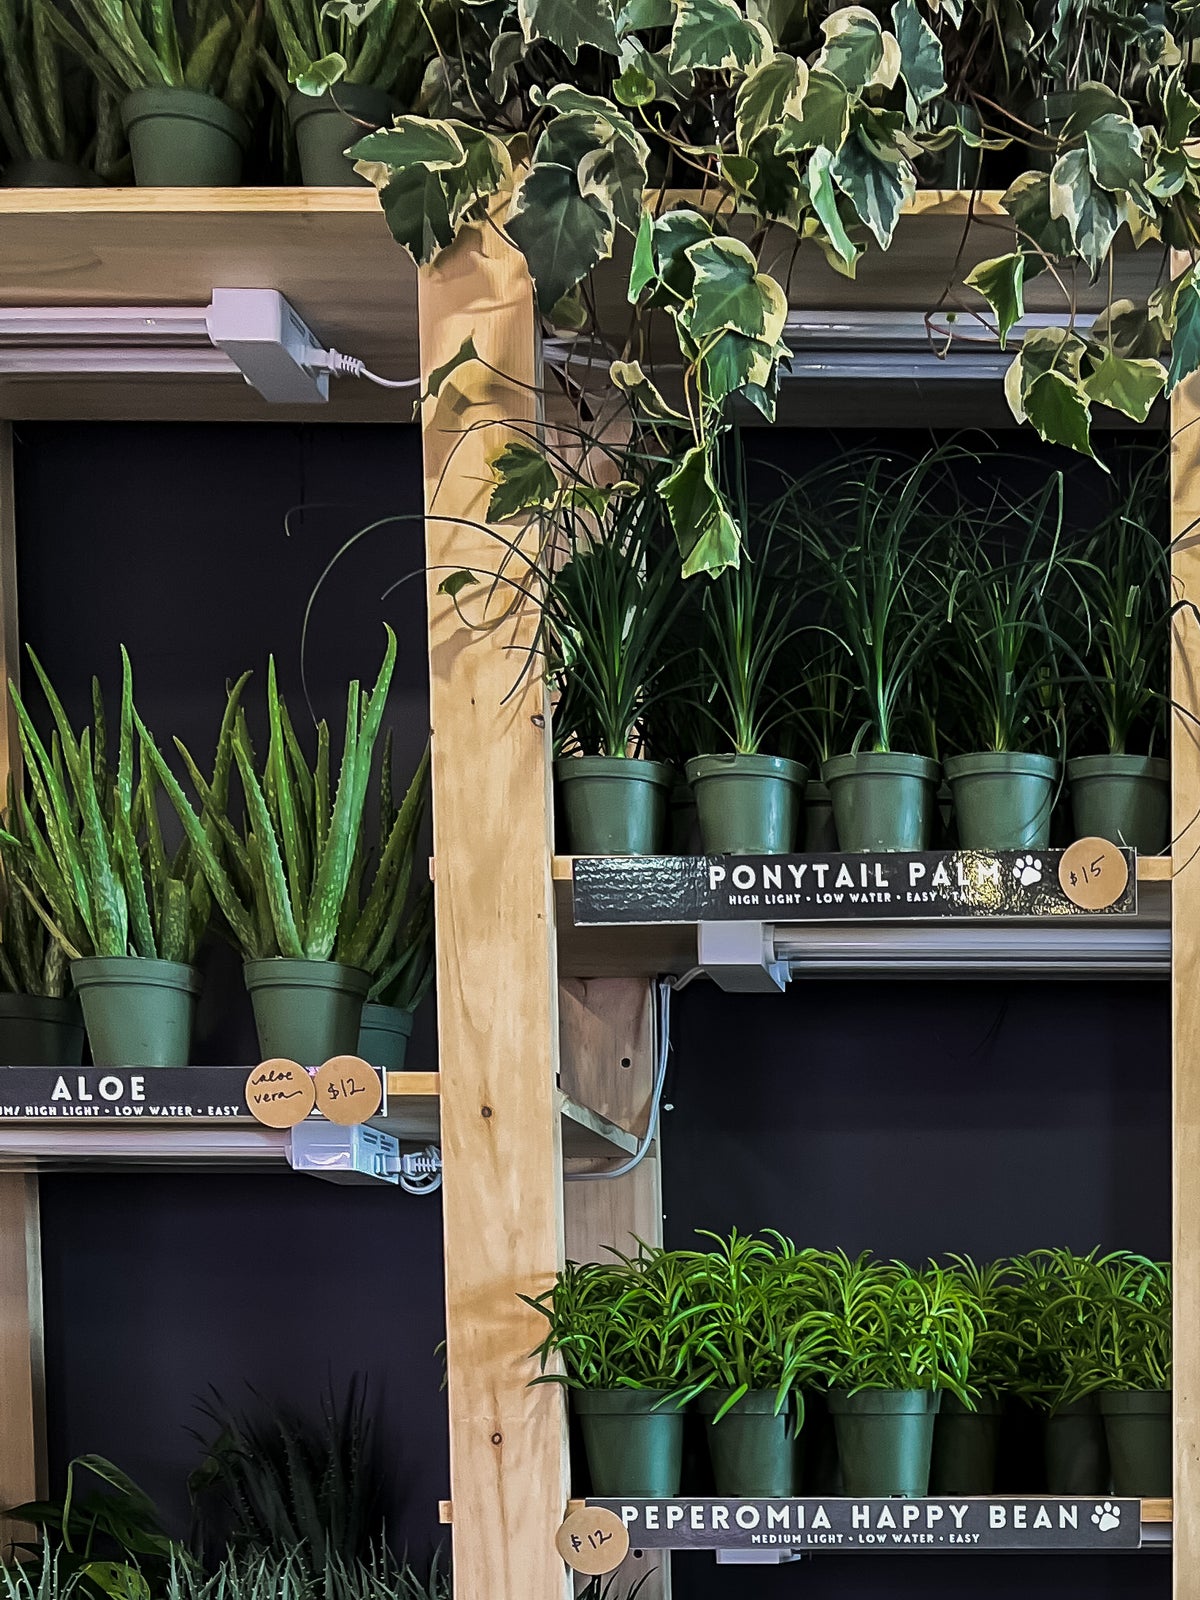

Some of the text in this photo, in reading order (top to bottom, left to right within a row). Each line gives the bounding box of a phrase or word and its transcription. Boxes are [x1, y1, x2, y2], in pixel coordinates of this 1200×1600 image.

[709, 861, 1001, 889] PONYTAIL PALM
[728, 890, 938, 905] HIGH LIGHT LOW WATER EASY
[52, 1076, 145, 1100] ALOE
[253, 1090, 303, 1104] vera
[25, 1105, 57, 1116] HIGH
[62, 1105, 100, 1116] LIGHT
[114, 1105, 144, 1116] LOW
[148, 1105, 194, 1116] WATER
[207, 1105, 240, 1116] EASY
[622, 1505, 1077, 1529] PEPEROMIA HAPPY BEAN
[751, 1533, 980, 1544] MEDIUM LIGHT LOW WATER EASY
